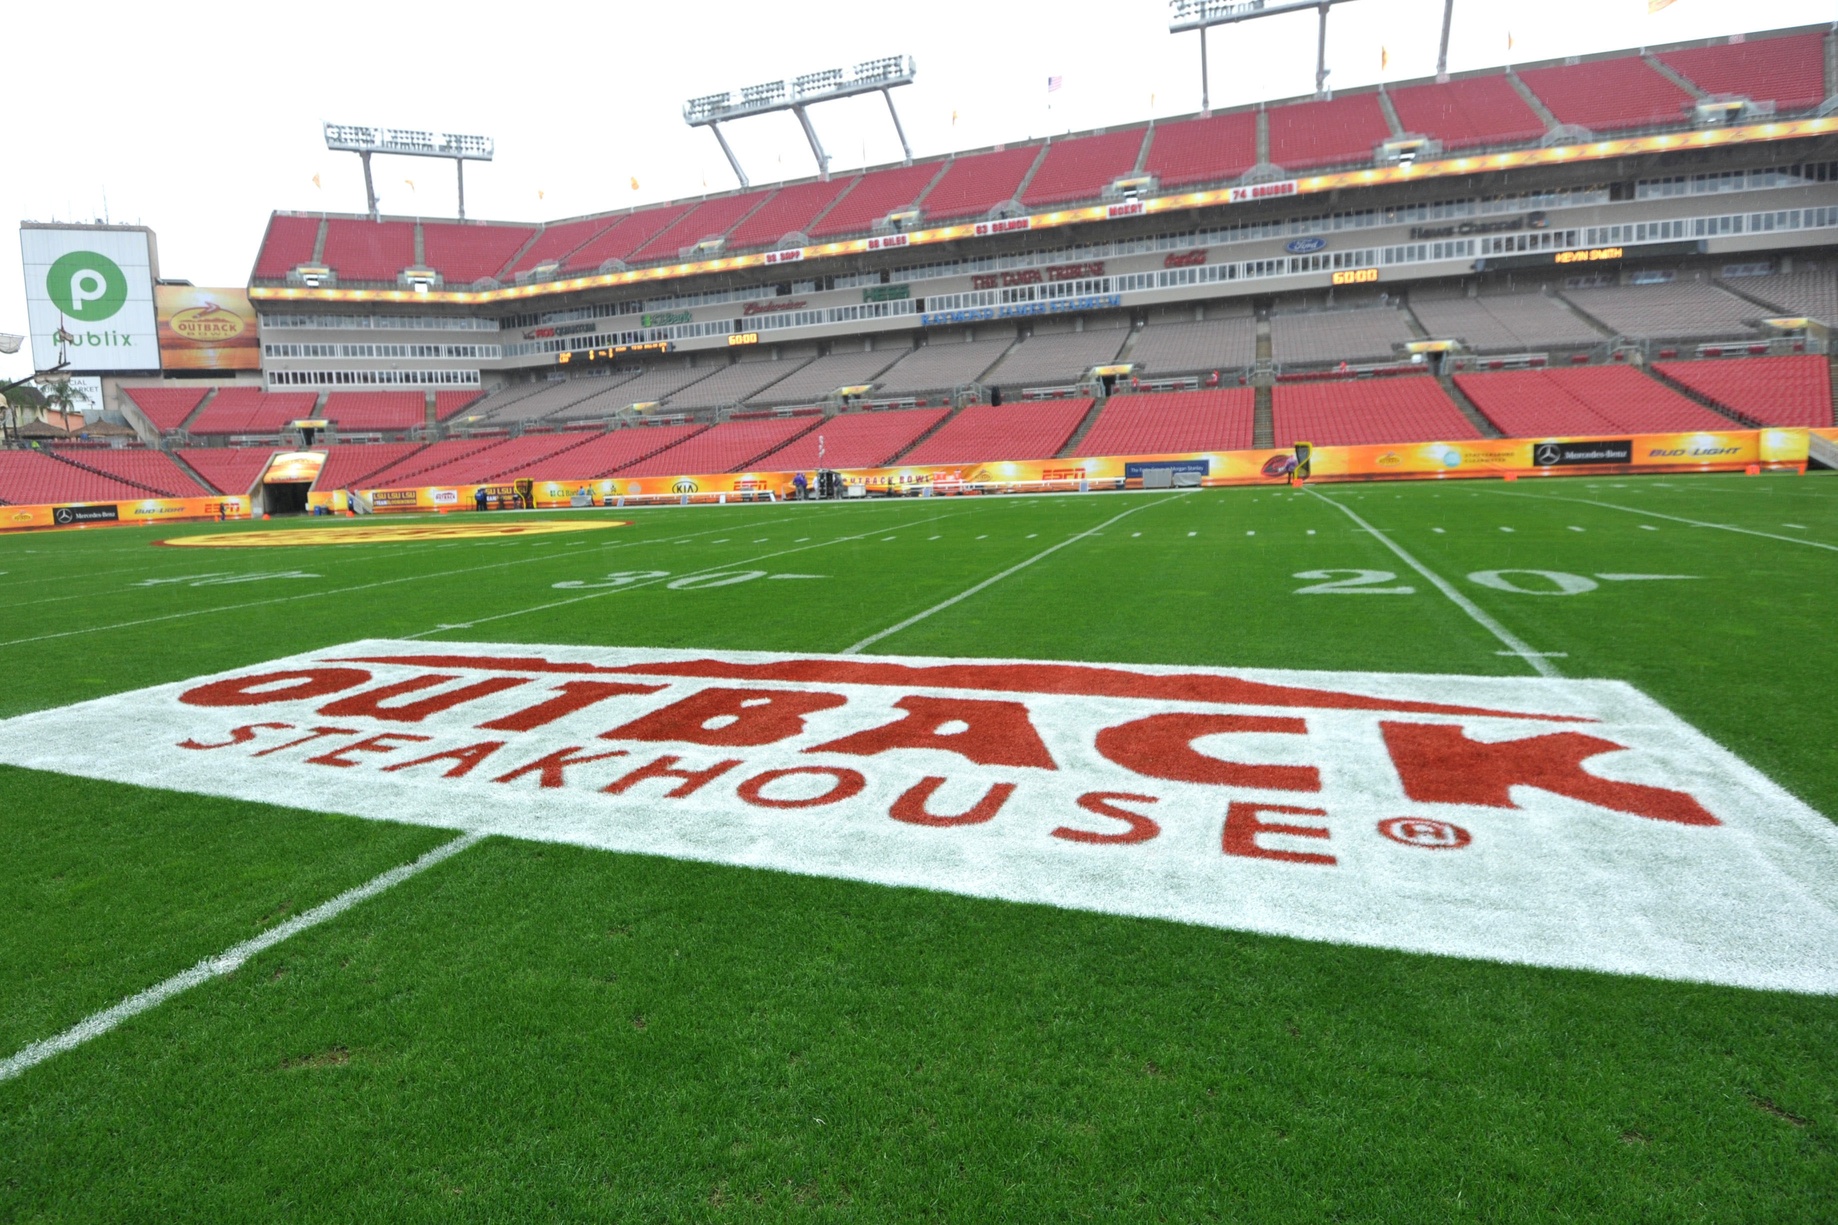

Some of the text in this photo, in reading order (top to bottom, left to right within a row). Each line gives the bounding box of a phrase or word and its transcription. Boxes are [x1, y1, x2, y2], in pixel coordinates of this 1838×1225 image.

[1555, 247, 1622, 263] KEVIN SMITH
[921, 295, 1121, 326] RAYMOND JAMES STADIUM
[178, 323, 237, 332] OUTBACK
[1565, 450, 1627, 460] Mercedes-Benz
[1042, 468, 1086, 480] ESPN
[677, 485, 694, 493] KIA
[205, 503, 239, 513] ESN
[180, 667, 1721, 826] OUTBACK
[180, 721, 1338, 866] STEAKHOUSE
